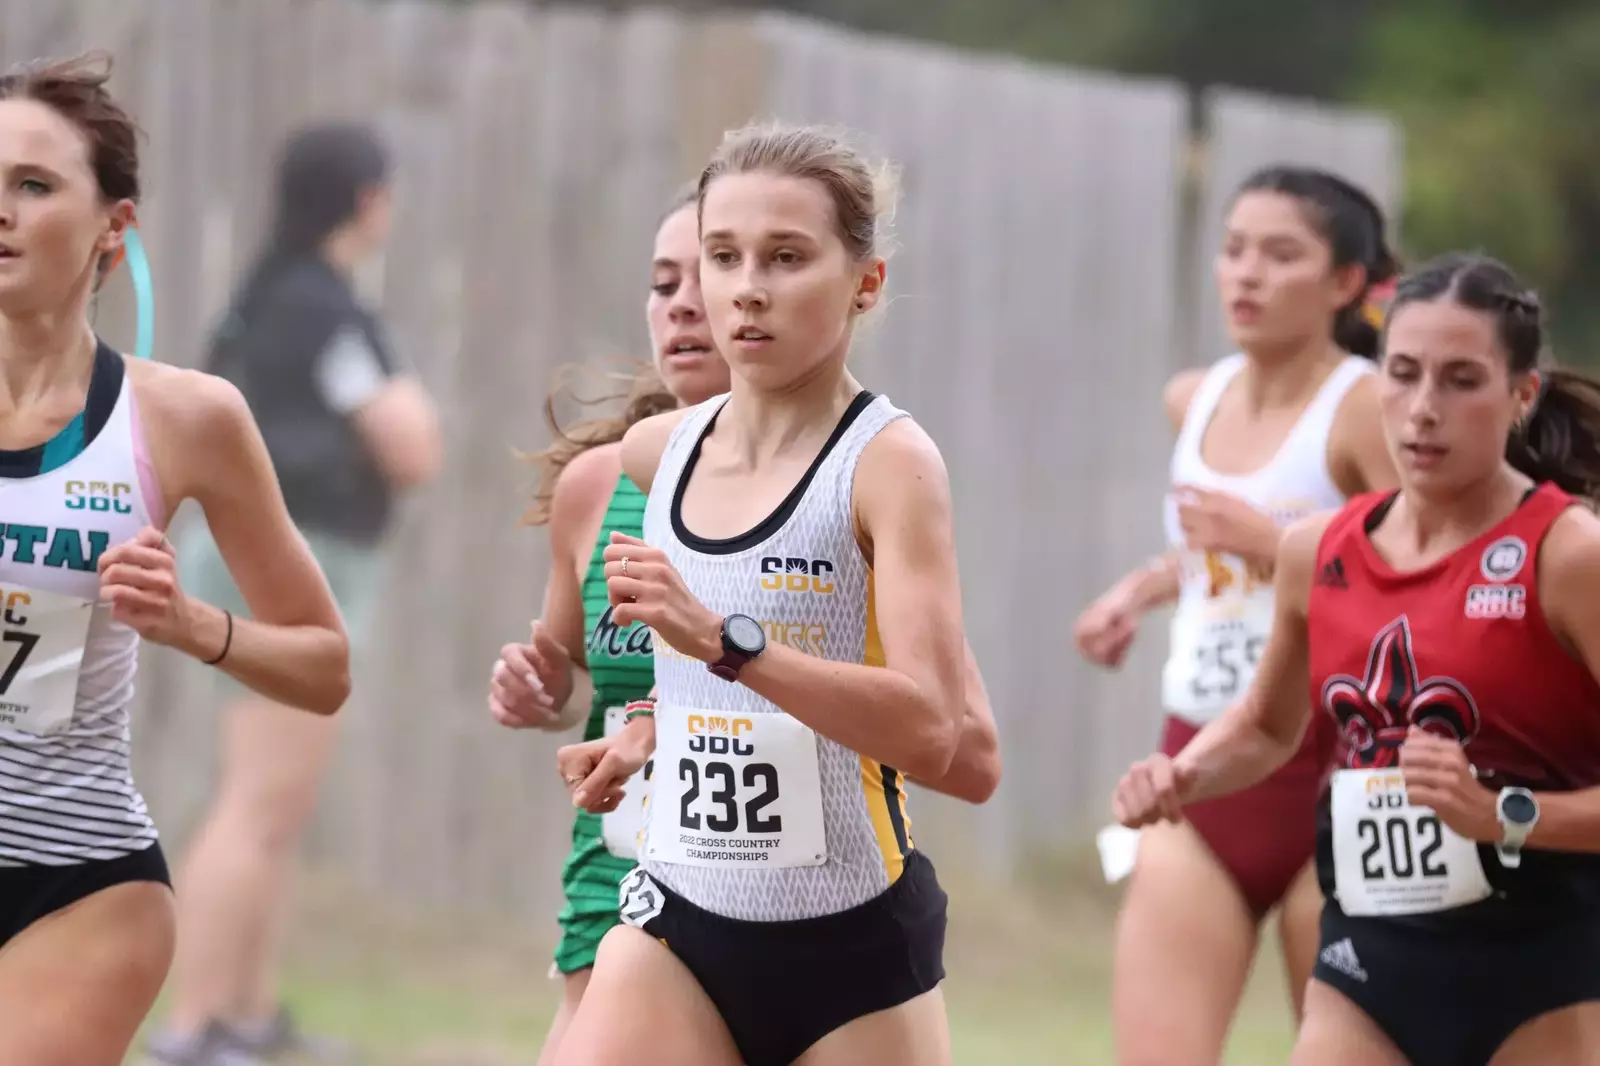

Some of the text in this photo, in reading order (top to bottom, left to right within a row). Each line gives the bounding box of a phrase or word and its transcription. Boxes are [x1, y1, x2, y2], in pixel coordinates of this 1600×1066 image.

[65, 480, 132, 514] SBC
[0, 523, 109, 572] TAL
[760, 556, 834, 594] SBC
[0, 589, 31, 625] C
[687, 714, 754, 756] SBC
[679, 758, 782, 833] 232
[1366, 776, 1406, 810] SB
[679, 833, 781, 849] 2022 CROSS COUNTRY
[686, 848, 769, 861] CHAMPIONSHIPS
[1358, 816, 1447, 880] 202
